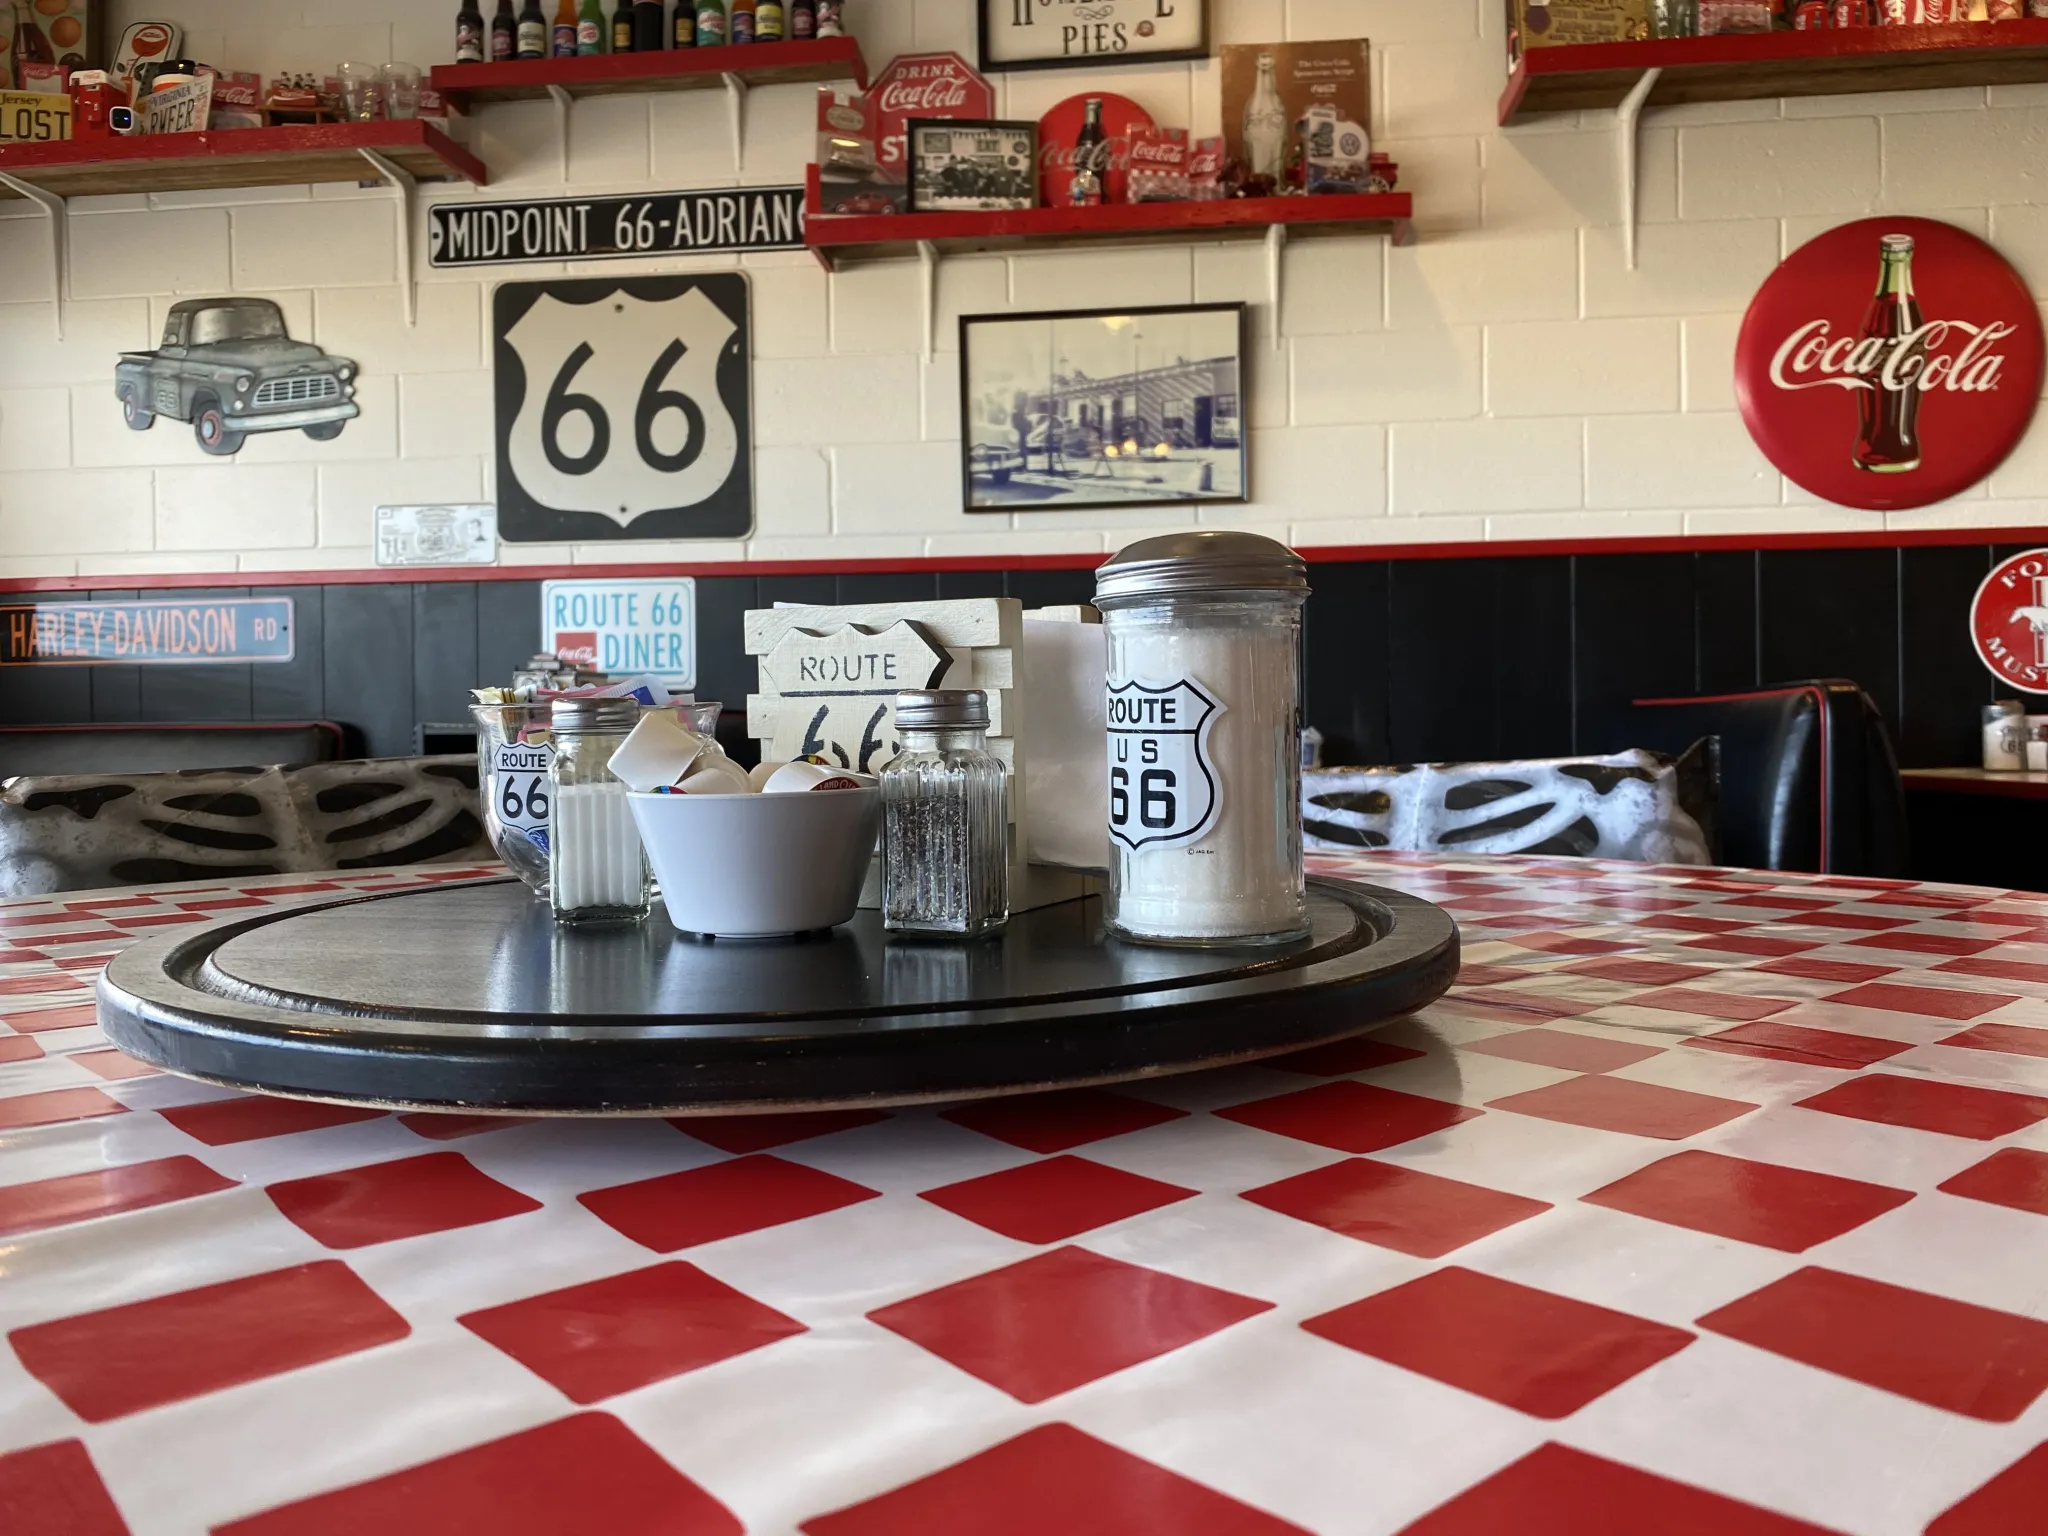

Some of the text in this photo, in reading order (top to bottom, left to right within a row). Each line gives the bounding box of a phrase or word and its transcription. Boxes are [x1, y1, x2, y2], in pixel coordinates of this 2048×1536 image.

[1062, 22, 1128, 55] PIES
[895, 63, 956, 79] DRINK
[0, 93, 42, 106] Jersey
[880, 77, 969, 112] Coca-Cola
[0, 108, 70, 140] LOST
[1132, 141, 1184, 163] Coca-Cola
[448, 206, 591, 259] MIDPOINT
[1769, 319, 2019, 392] Coca-Cola
[541, 337, 706, 475] 66
[2000, 560, 2048, 589] FO
[554, 592, 683, 627] ROUTE 66
[10, 608, 278, 658] HARLEY-DAVIDSON RD
[558, 646, 594, 660] Coca-Cola
[604, 633, 683, 669] DINER
[800, 653, 896, 681] ROUTE
[1108, 697, 1176, 724] ROUTE
[502, 753, 546, 768] ROUTE
[502, 775, 549, 820] 66
[1111, 766, 1176, 828] 66
